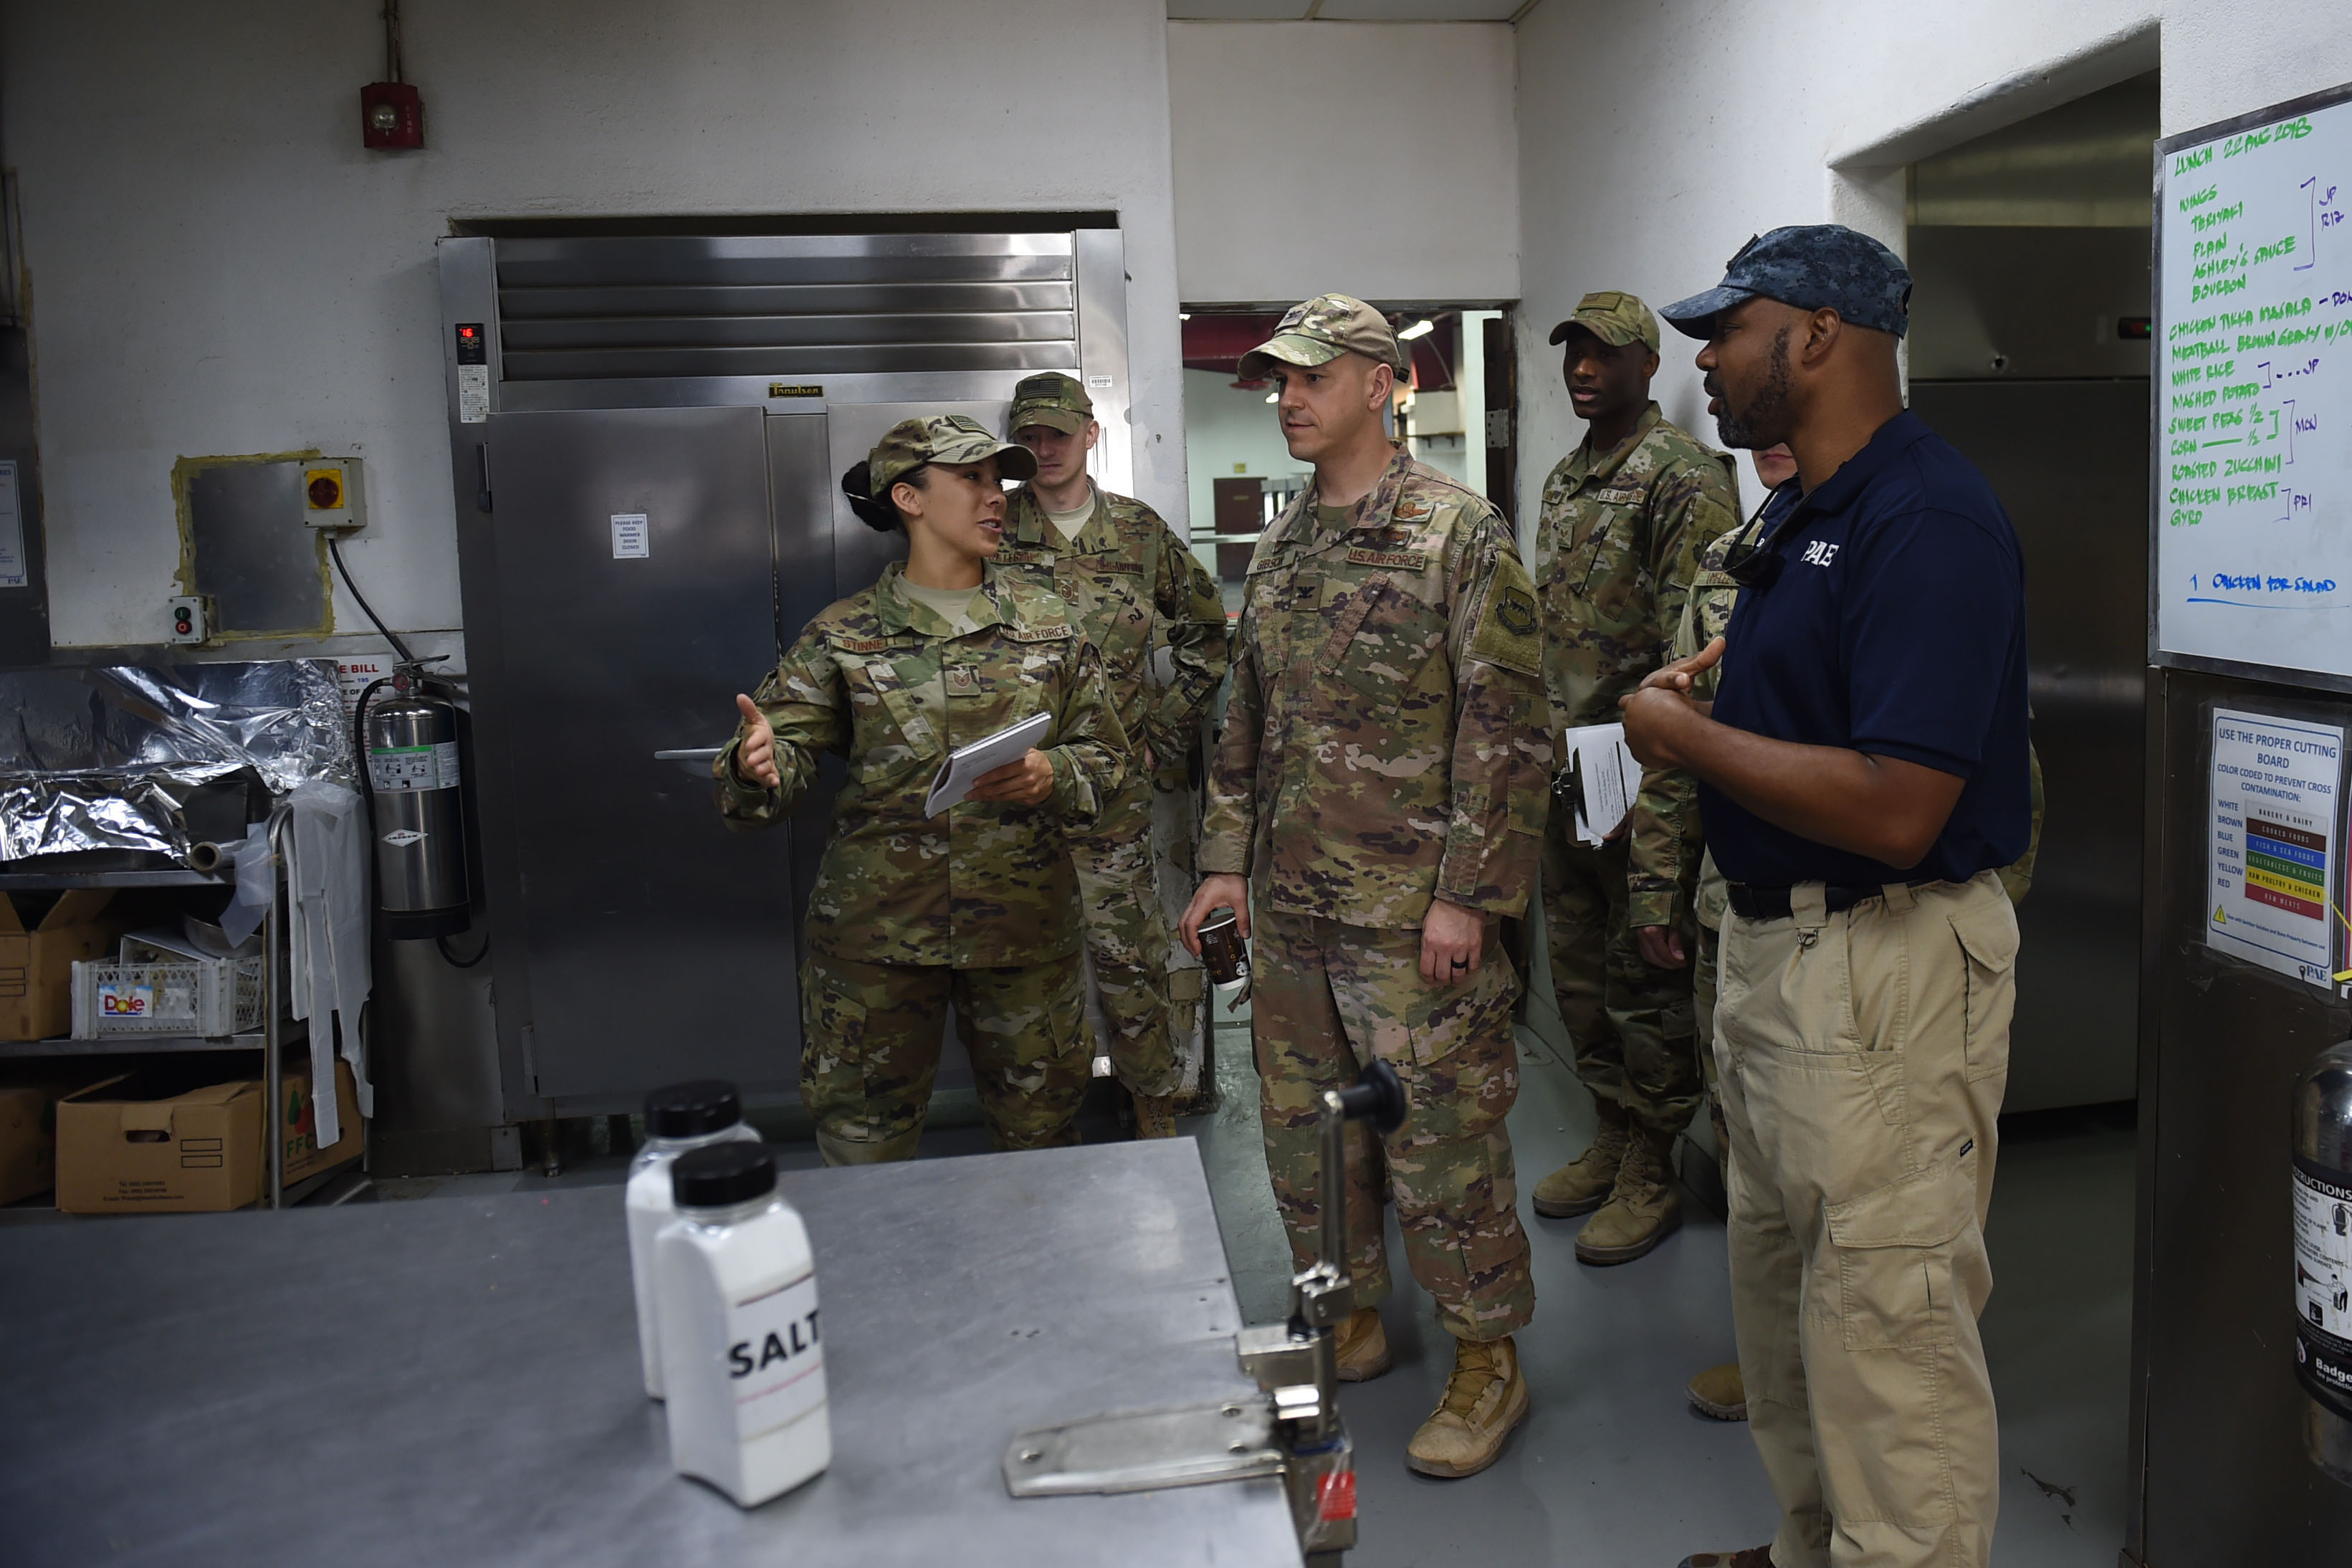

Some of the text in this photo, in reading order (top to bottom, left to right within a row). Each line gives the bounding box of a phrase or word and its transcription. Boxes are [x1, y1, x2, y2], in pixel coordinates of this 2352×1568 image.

[2174, 116, 2313, 177] LUNCH 22 AUG 2018
[2179, 183, 2218, 214] WINGS
[2191, 201, 2243, 234] TERIYAKI
[2194, 231, 2227, 261] PLAIN
[2191, 236, 2296, 282] ASHLEY'S SAUCE
[2191, 273, 2246, 304] BOURBON
[2169, 315, 2216, 341] CHICKEN
[2219, 310, 2254, 332] TIKKA
[2259, 297, 2311, 323] MASALA
[2172, 338, 2230, 365] MEATBALL
[2237, 330, 2275, 353] BROWN
[2277, 324, 2320, 346] GRAVY
[2172, 367, 2202, 388] WHITE
[2207, 360, 2235, 381] RICE
[2172, 383, 2260, 412] MASHED POTATO
[2169, 416, 2207, 434] SWEET
[2212, 408, 2243, 429] PEAS
[2171, 439, 2197, 456] CORN
[2171, 454, 2281, 483] ROASTED ZUCCHINI
[2169, 486, 2220, 506] CHICKEN
[2227, 481, 2279, 506] BREAST
[2171, 508, 2202, 527] GYRO
[1257, 555, 1283, 570] GIBSON
[1367, 552, 1386, 565] AIR
[1387, 554, 1423, 568] FORCE
[1800, 540, 1840, 567] PAE
[2212, 573, 2261, 591] CHICKEN
[2267, 575, 2293, 593] FOR
[2295, 577, 2336, 593] SALAD
[1018, 631, 1034, 641] AIR
[1035, 626, 1069, 639] FORCE
[351, 664, 379, 674] BILL
[2219, 727, 2337, 758] USE THE PROPER CUTTING
[2257, 753, 2290, 769] BOARD
[2217, 764, 2331, 794] COLOR CODED TO PREVENT CROSS
[2241, 782, 2301, 803] CONTAMINATION:
[2218, 799, 2239, 811] WHITE
[2217, 815, 2243, 828] BROWN
[2259, 808, 2282, 820] BAKERY
[2293, 816, 2313, 827] DAIRY
[2217, 831, 2234, 842] BLUE
[2262, 826, 2310, 844] COOKED FOODS
[2217, 846, 2239, 859] GREEN
[2256, 841, 2270, 850] FISH
[2280, 847, 2291, 856] SEA
[2295, 850, 2315, 862] FOODS
[2217, 862, 2243, 876] YELLOW
[2299, 869, 2323, 882] FRUITS
[2217, 877, 2230, 889] RED
[2249, 871, 2260, 880] RAW
[2262, 874, 2285, 889] POULTRY
[2295, 885, 2320, 899] CHICKEN
[2265, 893, 2300, 909] RAW MEATS
[2306, 965, 2326, 982] PAE
[105, 995, 145, 1013] Dole
[730, 1309, 820, 1379] SALT
[2316, 1357, 2352, 1383] Badge
